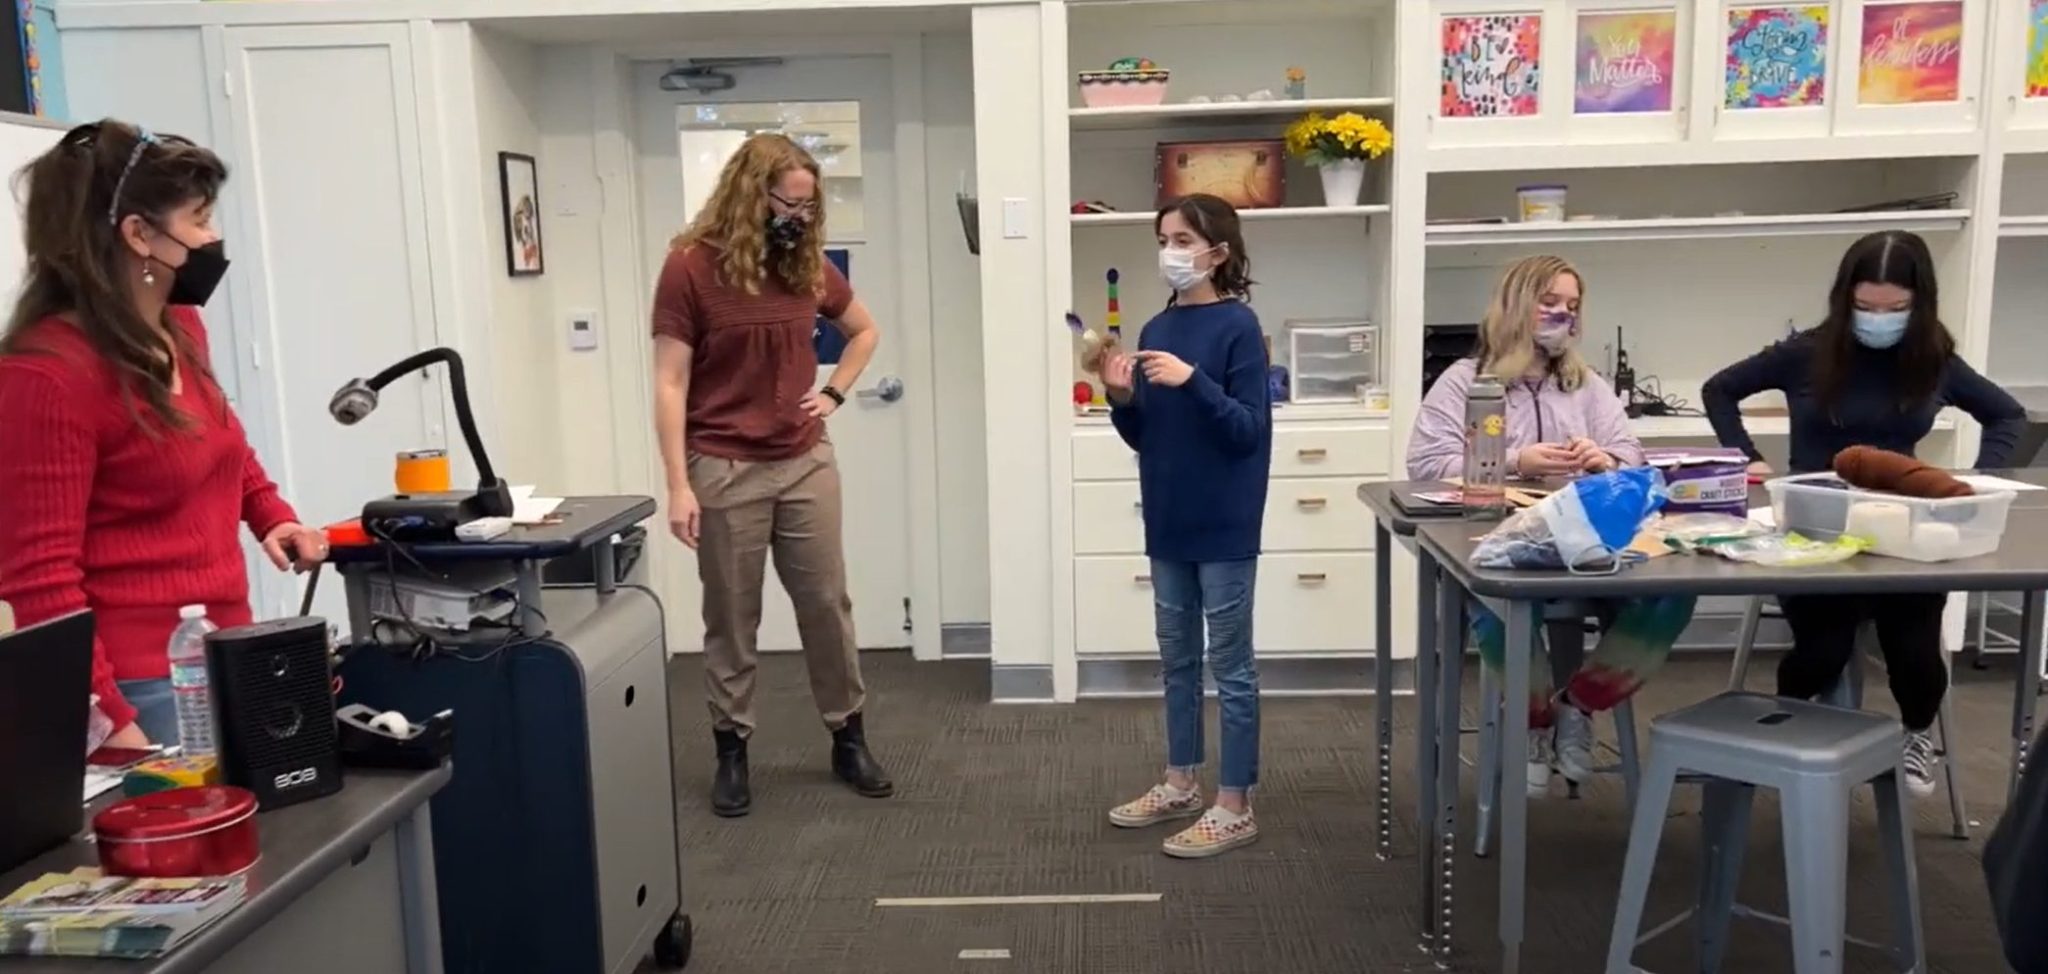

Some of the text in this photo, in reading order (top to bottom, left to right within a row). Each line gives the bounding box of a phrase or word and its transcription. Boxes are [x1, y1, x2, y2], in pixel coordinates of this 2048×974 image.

[1470, 34, 1499, 63] BE
[1589, 55, 1663, 88] Matter
[274, 766, 317, 789] 808
